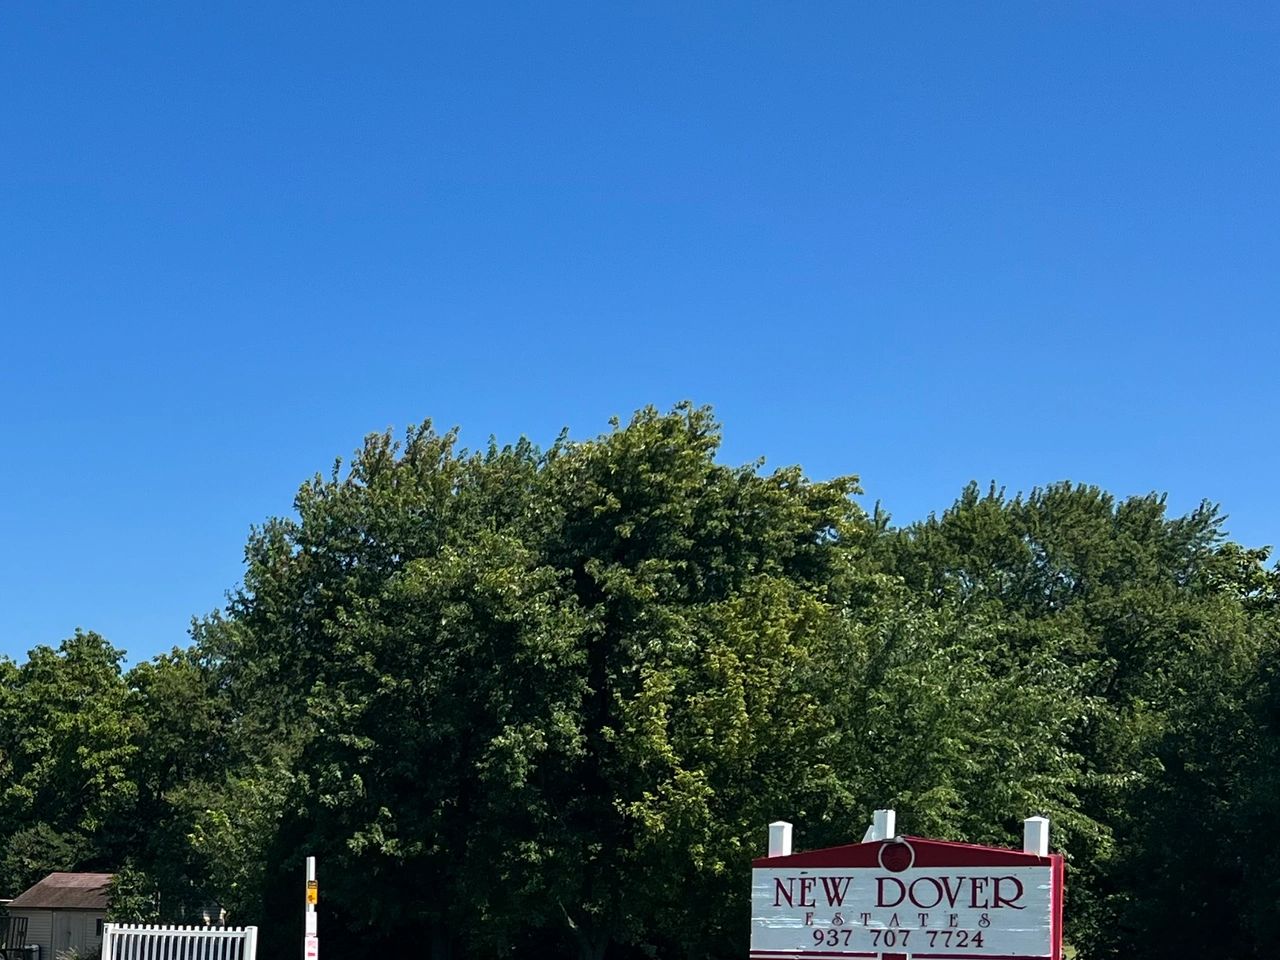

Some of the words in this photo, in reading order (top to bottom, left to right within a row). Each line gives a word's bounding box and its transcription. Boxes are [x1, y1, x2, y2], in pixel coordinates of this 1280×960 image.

[773, 876, 854, 908] NEW
[874, 876, 1027, 910] DOVER
[805, 911, 991, 928] ESTATES
[812, 929, 853, 947] 937
[870, 929, 911, 948] 707
[926, 930, 984, 948] 7724
